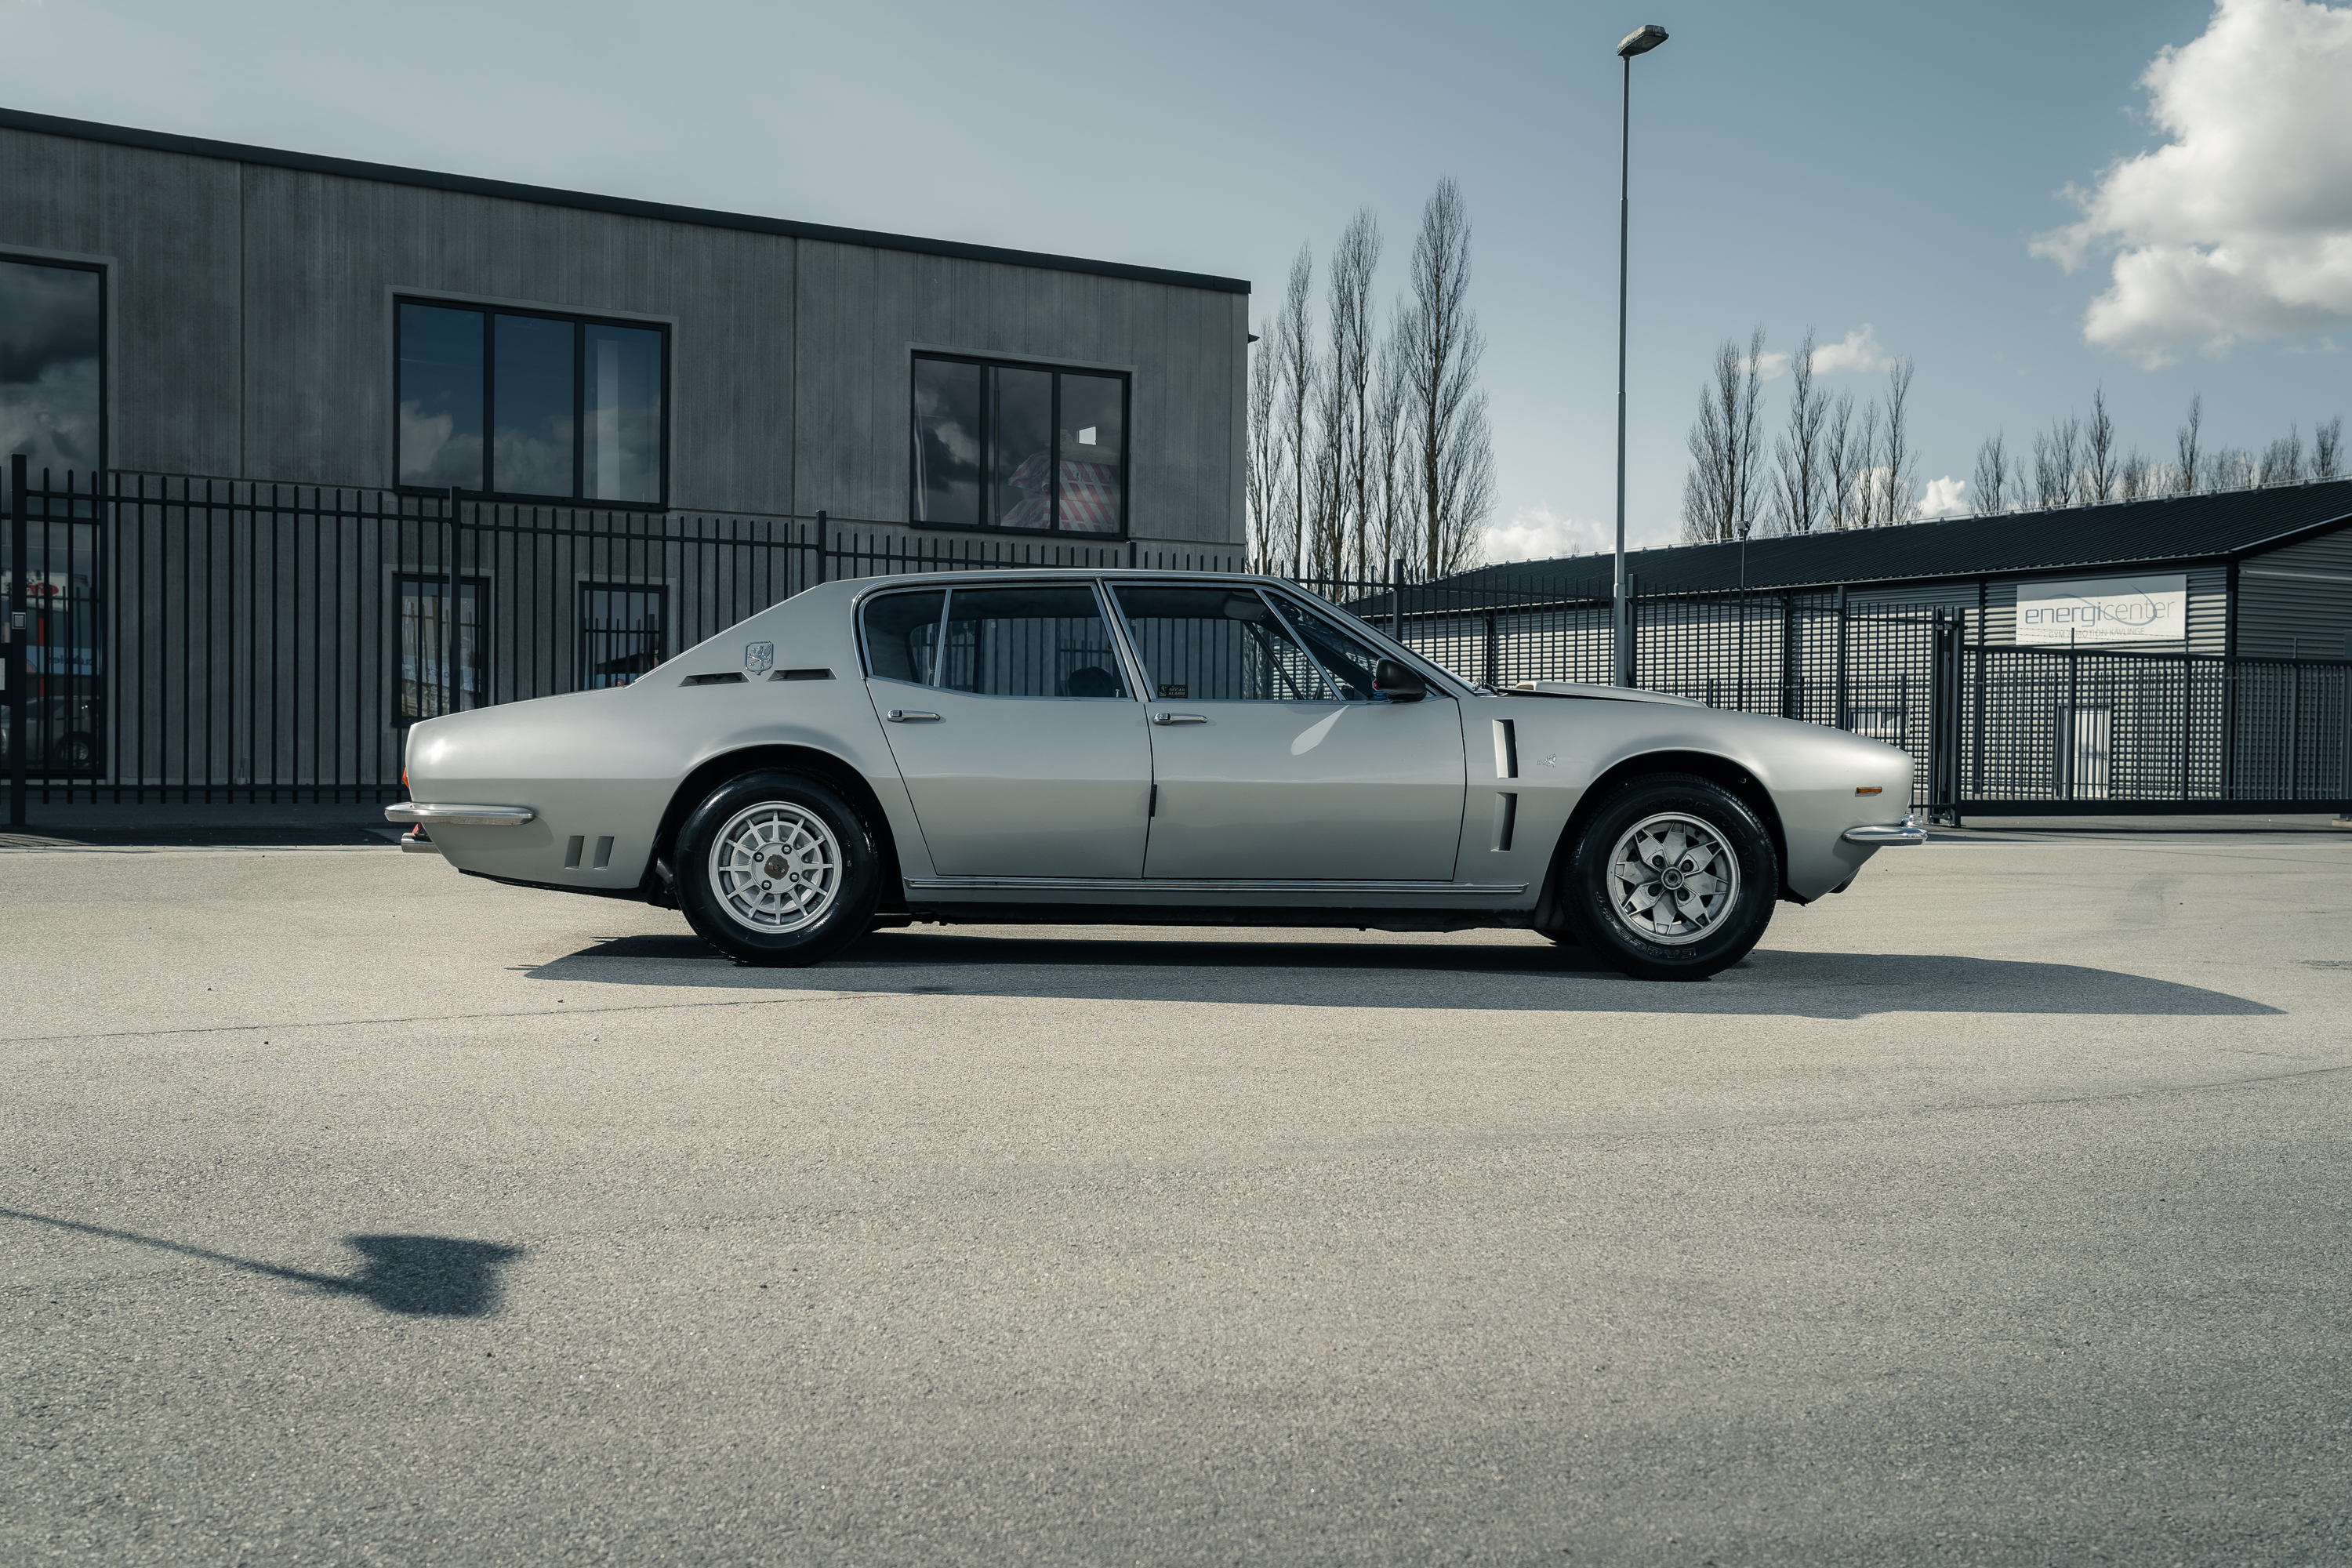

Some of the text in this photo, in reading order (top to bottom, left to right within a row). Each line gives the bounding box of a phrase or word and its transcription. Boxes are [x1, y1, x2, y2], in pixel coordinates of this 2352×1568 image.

[2075, 629, 2107, 637] MOTION
[2109, 627, 2145, 636] KÄVLINGE
[1646, 797, 1757, 873] GOODYEAR
[1595, 891, 1697, 959] EAGLE GT
